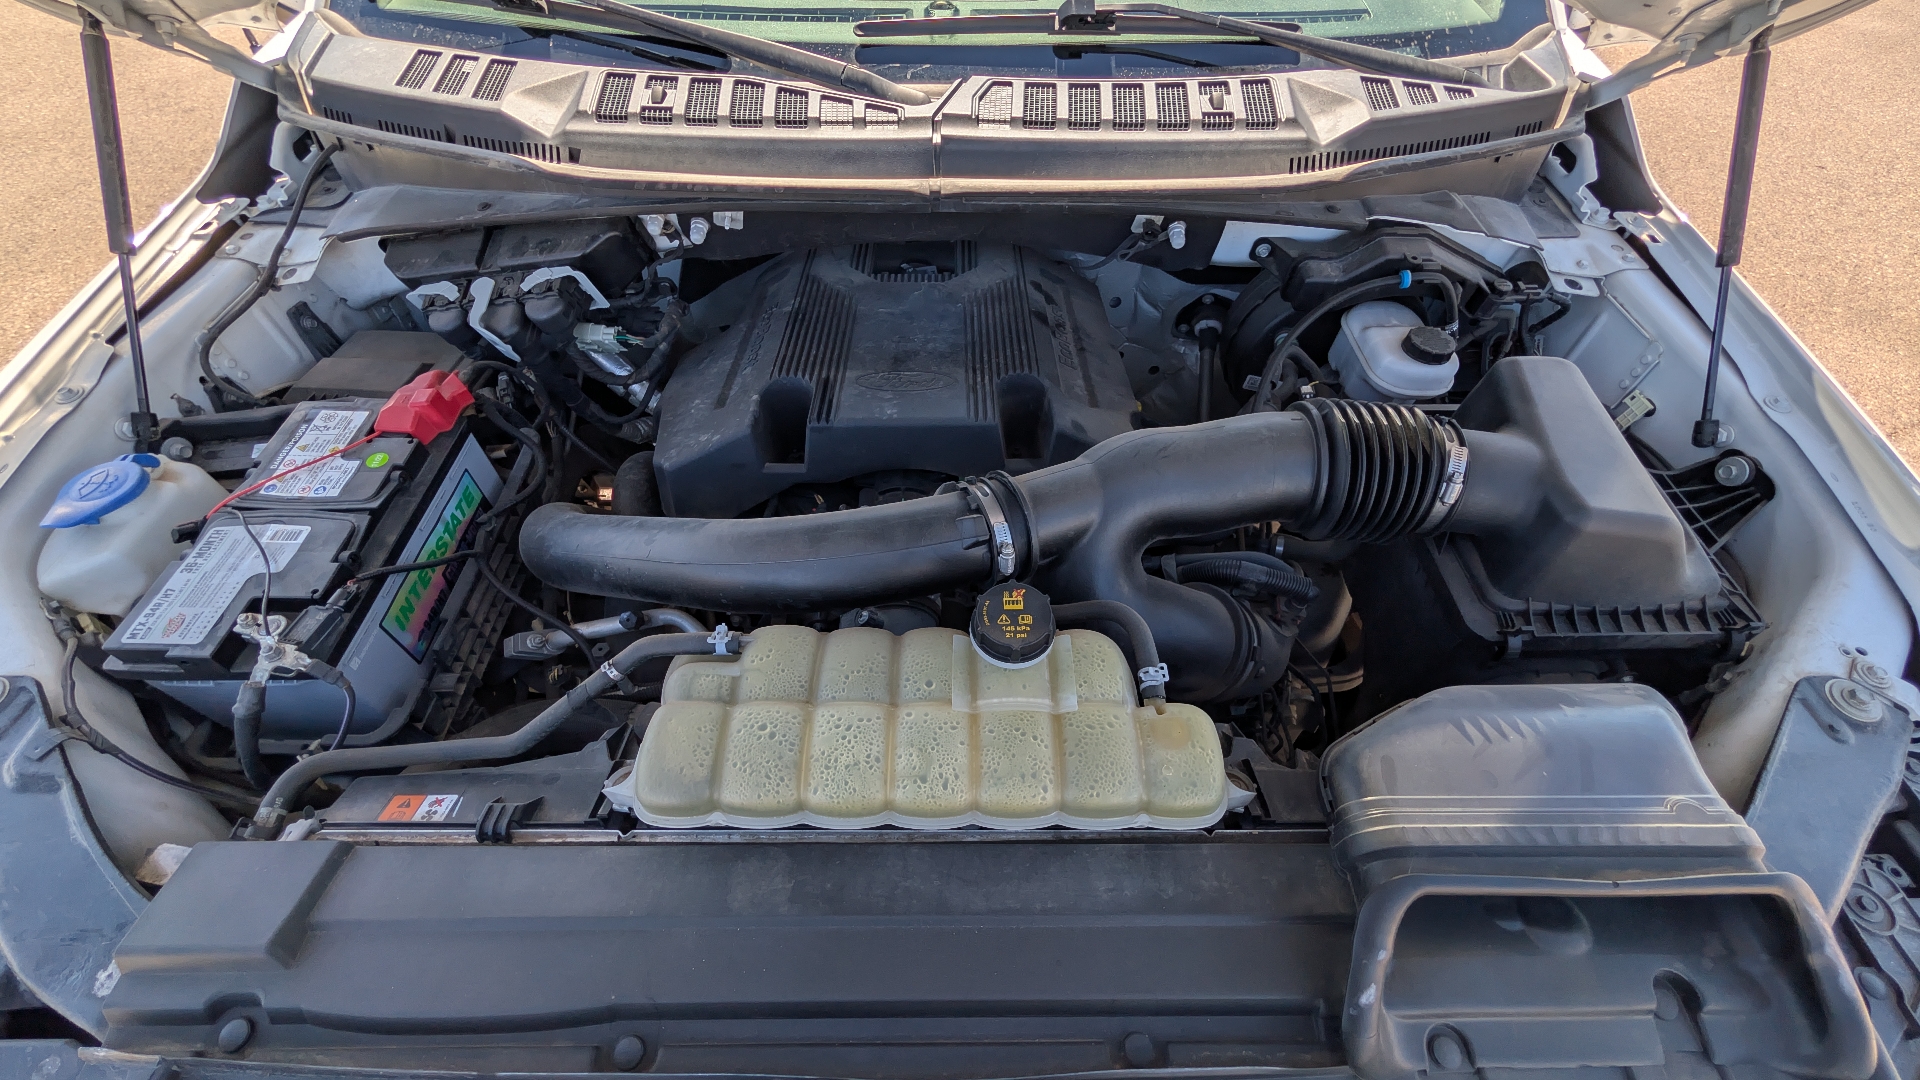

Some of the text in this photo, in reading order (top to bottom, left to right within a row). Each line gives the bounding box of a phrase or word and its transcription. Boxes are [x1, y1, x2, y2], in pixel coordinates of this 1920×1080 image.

[269, 423, 310, 470] DANGER/POISON
[179, 529, 225, 574] 36-MONTH
[394, 484, 475, 632] INTERSTATE
[126, 588, 177, 640] MTX-94R/H7
